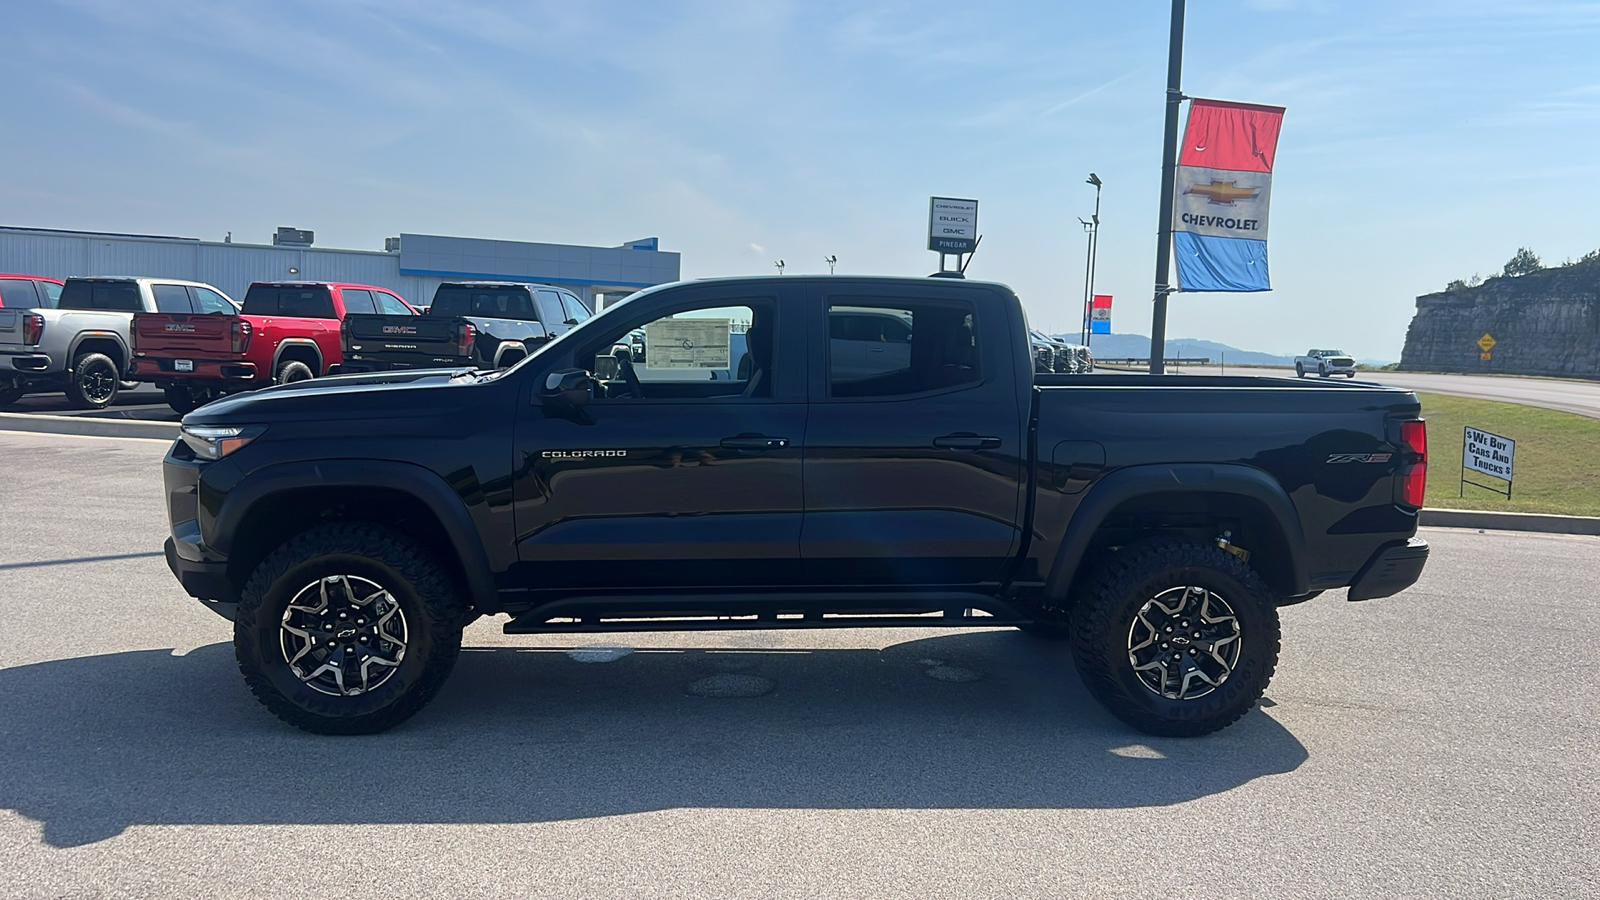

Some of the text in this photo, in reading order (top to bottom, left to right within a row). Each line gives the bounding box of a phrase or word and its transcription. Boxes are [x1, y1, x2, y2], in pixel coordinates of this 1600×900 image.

[939, 215, 970, 223] BUICK
[1181, 212, 1258, 231] CHEVROLET
[942, 227, 966, 235] GMC
[164, 323, 196, 332] GMC
[382, 325, 417, 334] GMC
[541, 450, 627, 458] COLORADO
[1326, 453, 1392, 464] ZR2
